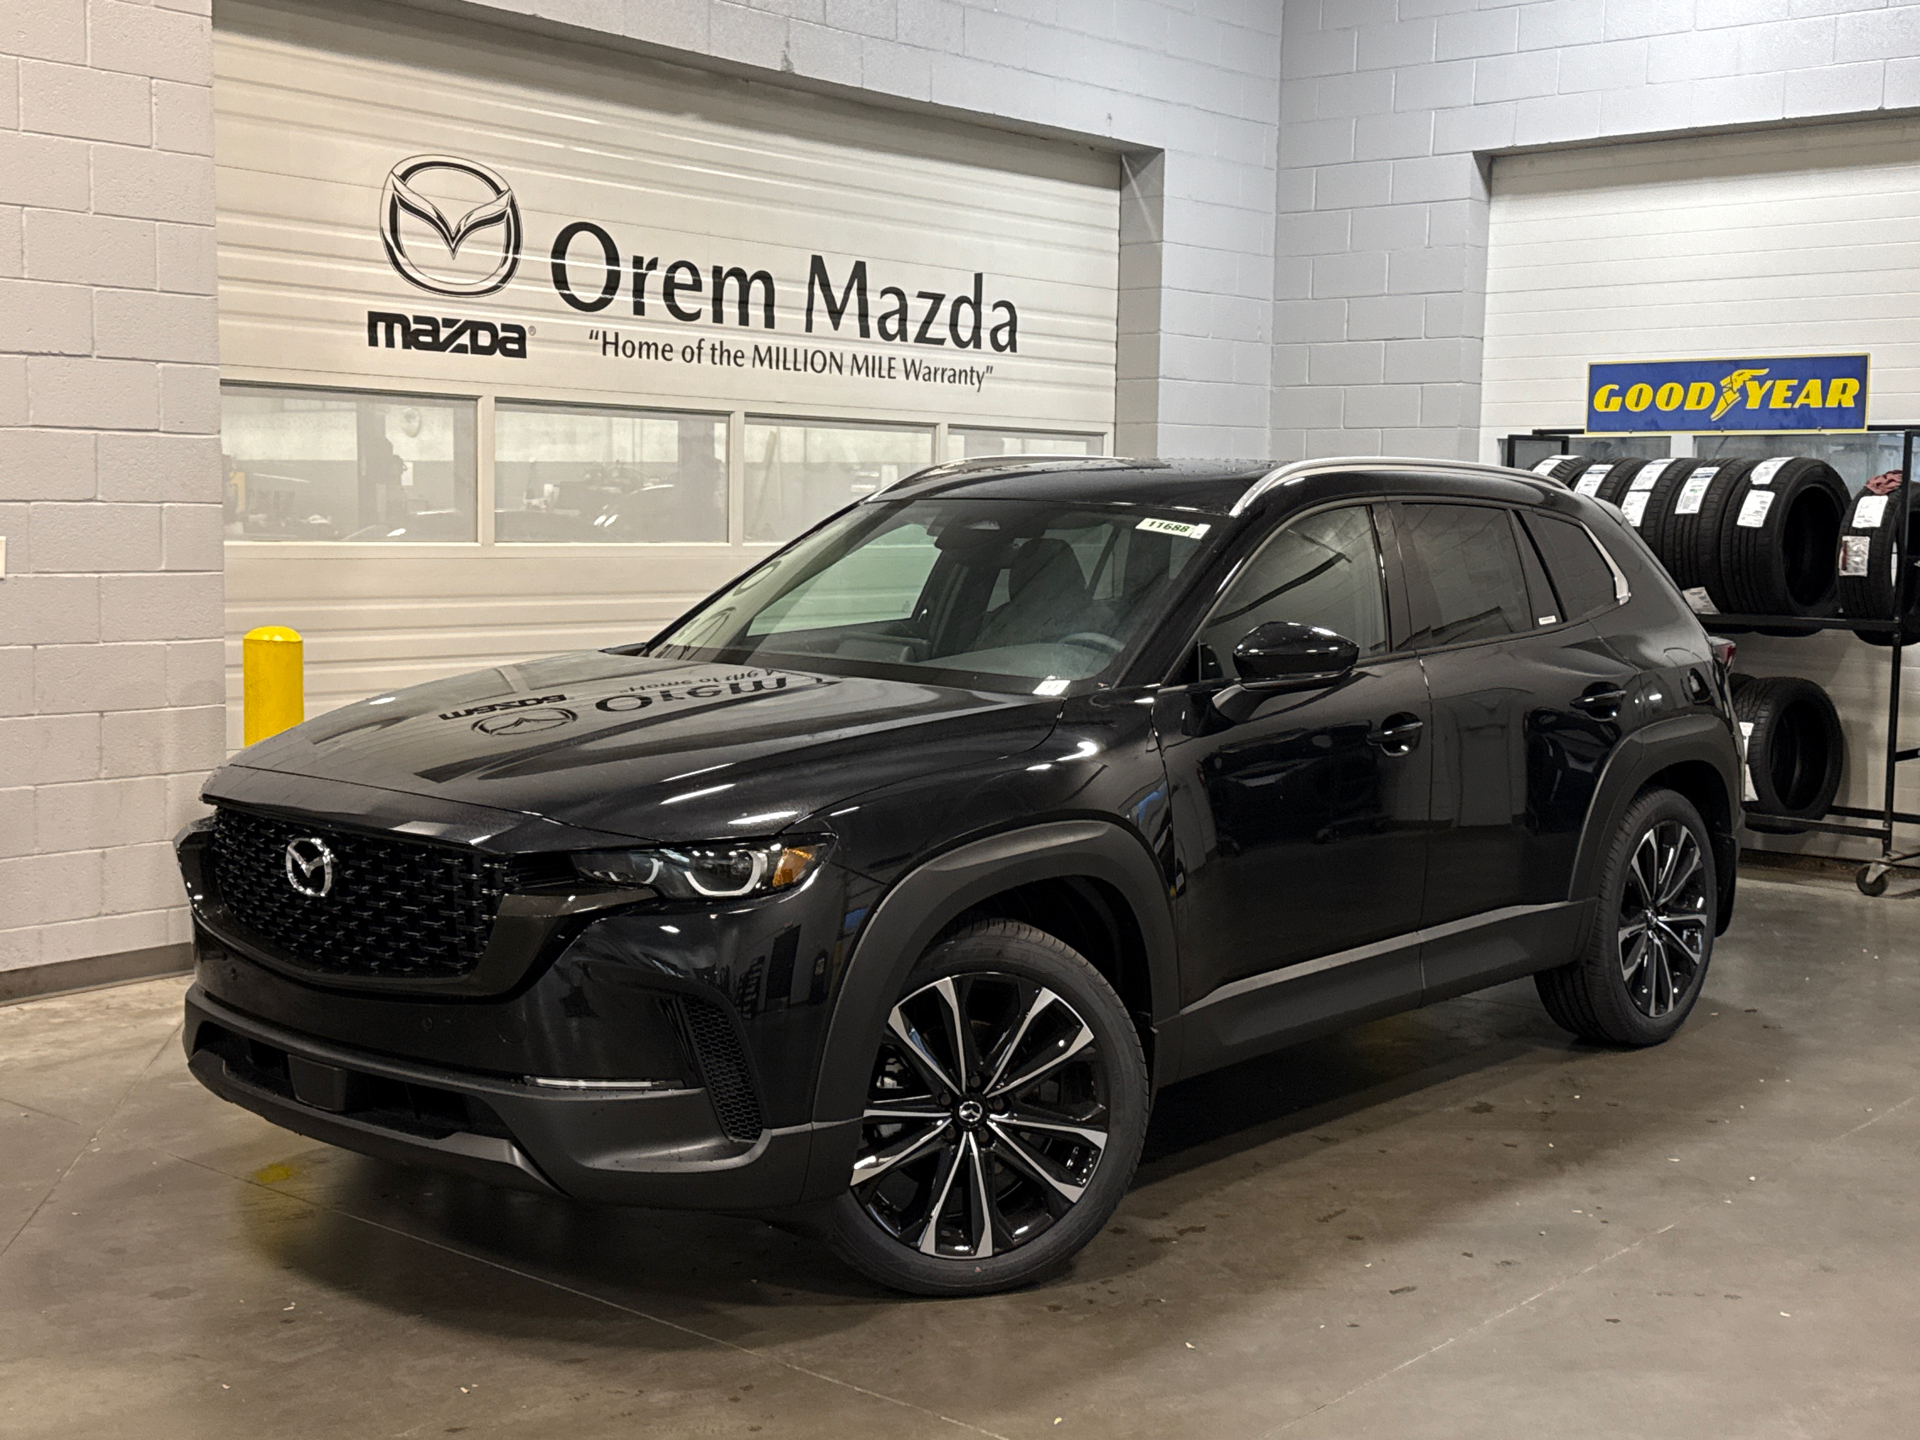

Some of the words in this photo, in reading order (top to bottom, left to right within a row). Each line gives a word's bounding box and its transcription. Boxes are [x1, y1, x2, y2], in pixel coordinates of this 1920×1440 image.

[551, 221, 775, 329] Orem
[805, 254, 1018, 353] Mazda
[367, 310, 527, 359] mazda
[589, 330, 673, 362] “Home
[681, 338, 705, 364] of
[710, 340, 745, 367] the
[752, 344, 843, 375] MILLION
[850, 353, 896, 379] MILE
[903, 358, 993, 393] Warranty”
